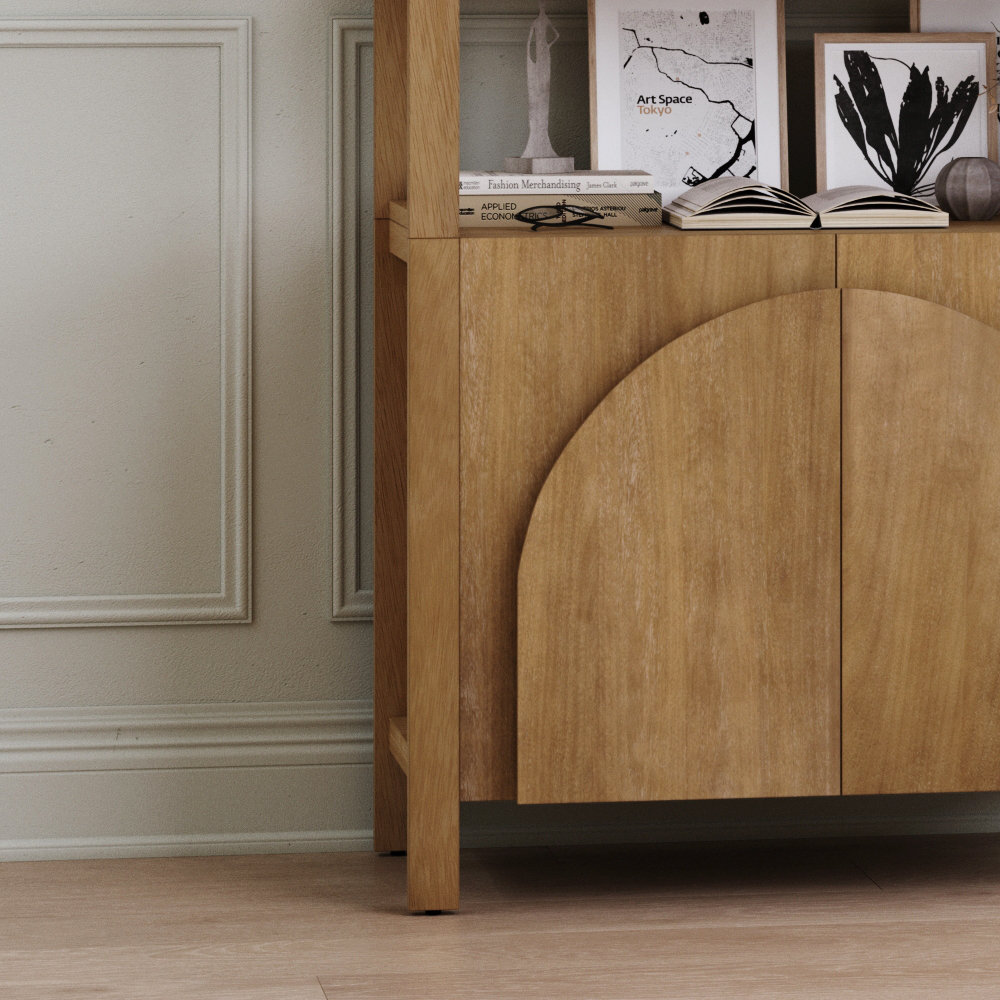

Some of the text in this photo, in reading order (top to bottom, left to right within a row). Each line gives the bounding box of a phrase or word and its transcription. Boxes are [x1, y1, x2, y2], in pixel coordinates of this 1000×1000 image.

[637, 95, 693, 106] Art Space
[637, 105, 672, 116] Tokyo
[488, 179, 519, 190] Fashion
[521, 179, 581, 192] Merchandising
[586, 181, 617, 190] James Clark
[481, 202, 517, 211] APPLIED
